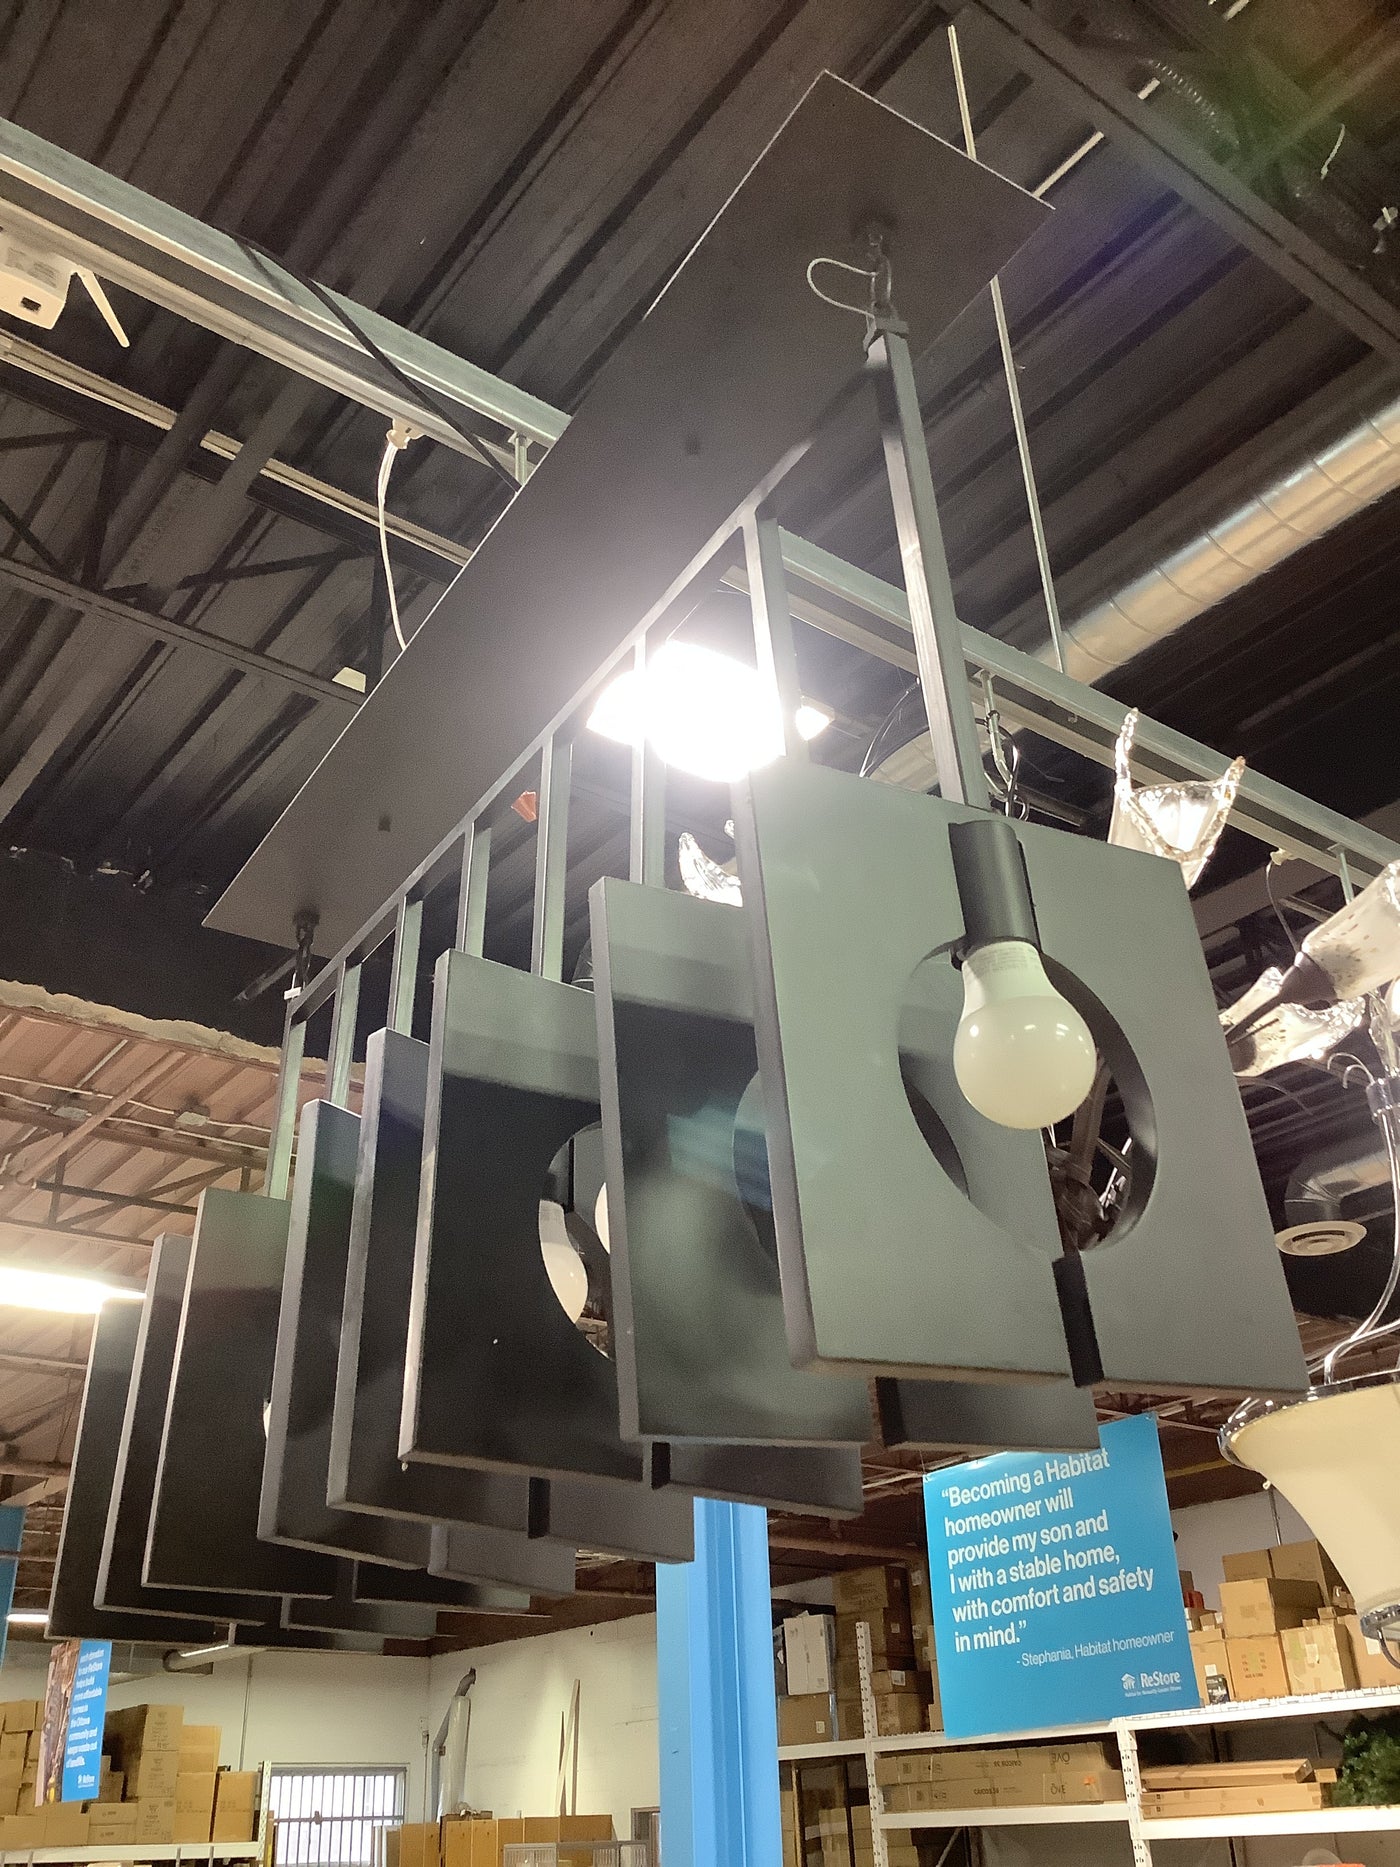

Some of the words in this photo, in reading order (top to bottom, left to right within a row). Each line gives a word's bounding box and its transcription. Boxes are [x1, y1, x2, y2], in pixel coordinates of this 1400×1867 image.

[1033, 1469, 1044, 1486] a
[1045, 1447, 1110, 1482] Habitat
[944, 1499, 1042, 1537] homeowner
[1044, 1487, 1073, 1512] will
[947, 1534, 1010, 1569] provide
[1012, 1531, 1037, 1553] my
[1040, 1523, 1073, 1546] son
[1075, 1509, 1109, 1537] and
[957, 1566, 994, 1592] with
[996, 1568, 1008, 1585] a
[1009, 1553, 1062, 1582] stable
[1063, 1544, 1120, 1570] home,
[952, 1598, 989, 1623] with
[991, 1584, 1061, 1616] comfort
[1062, 1575, 1097, 1602] and
[1098, 1566, 1154, 1595] safety
[954, 1631, 971, 1653] in
[1074, 1640, 1113, 1658] Habitat
[1112, 1630, 1175, 1651] homeowner
[1140, 1670, 1181, 1688] ReStore
